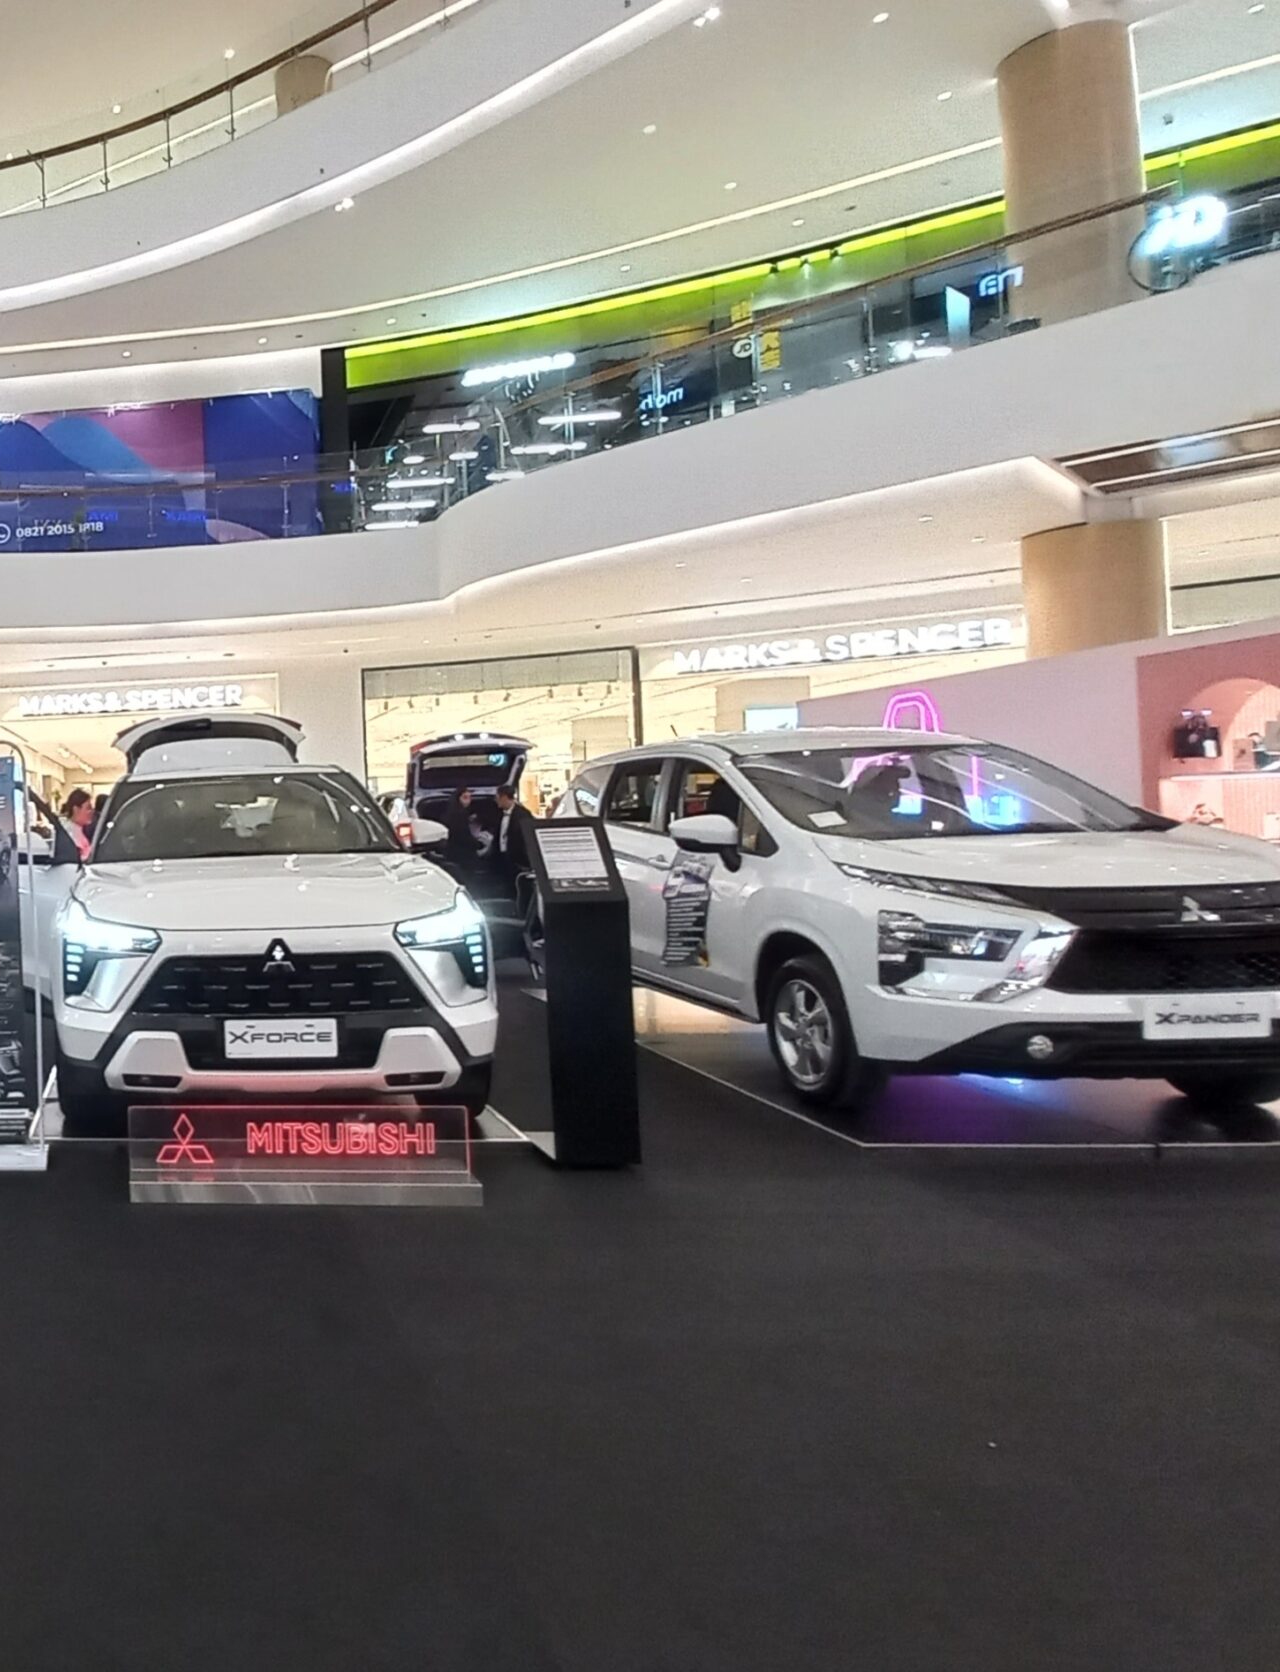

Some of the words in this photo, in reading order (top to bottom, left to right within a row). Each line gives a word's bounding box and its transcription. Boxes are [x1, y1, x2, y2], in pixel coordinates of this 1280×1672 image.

[16, 526, 44, 538] 0821
[47, 524, 73, 536] 2015
[672, 640, 792, 674] MARKS
[824, 618, 1011, 660] SPENCER
[19, 691, 103, 716] MARKS
[125, 684, 242, 711] SPENCER
[1155, 1012, 1260, 1025] XPANDER
[228, 1031, 333, 1044] XFORCE
[246, 1122, 436, 1155] MITSUBISHI
